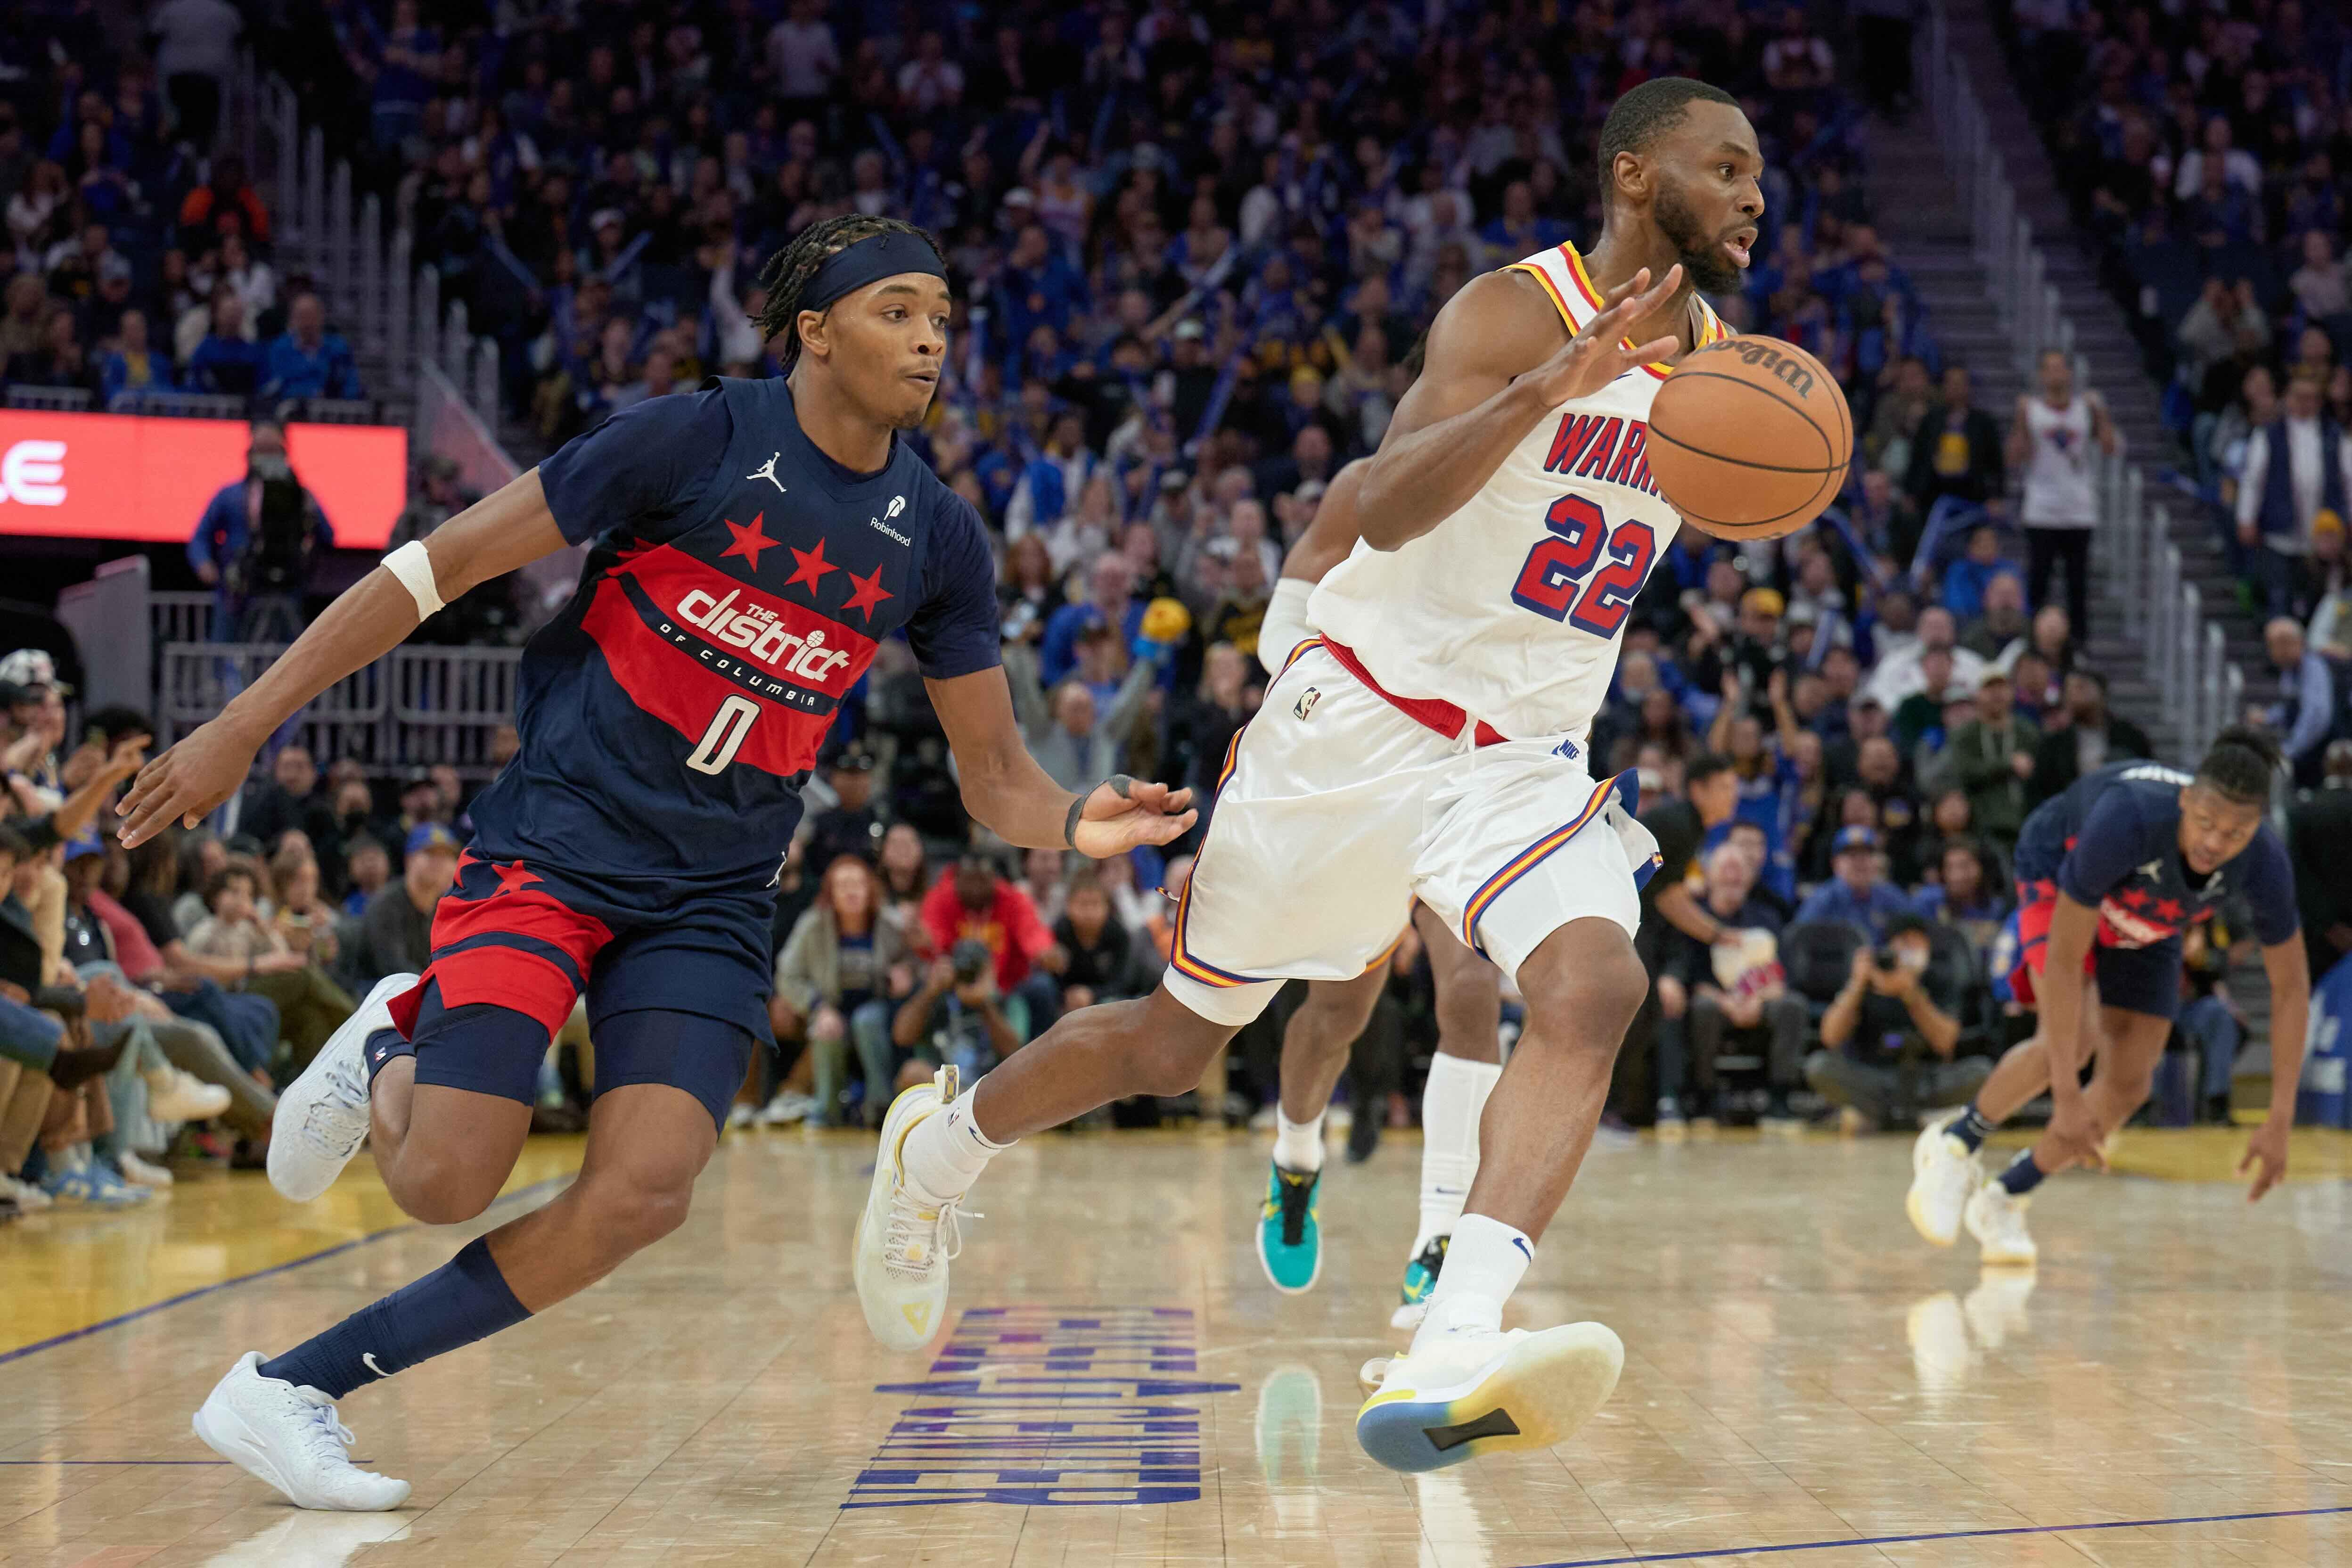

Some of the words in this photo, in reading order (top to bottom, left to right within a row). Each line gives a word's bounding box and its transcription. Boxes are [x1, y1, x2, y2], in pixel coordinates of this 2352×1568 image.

[0, 439, 68, 506] E
[1543, 413, 1667, 503] WAR
[870, 517, 911, 547] Robinhood
[1510, 493, 1656, 640] 22
[747, 603, 779, 623] THE
[660, 624, 687, 642] OF
[700, 649, 815, 706] COLUMBIA
[686, 694, 762, 775] 0
[1559, 739, 1580, 760] NIKE
